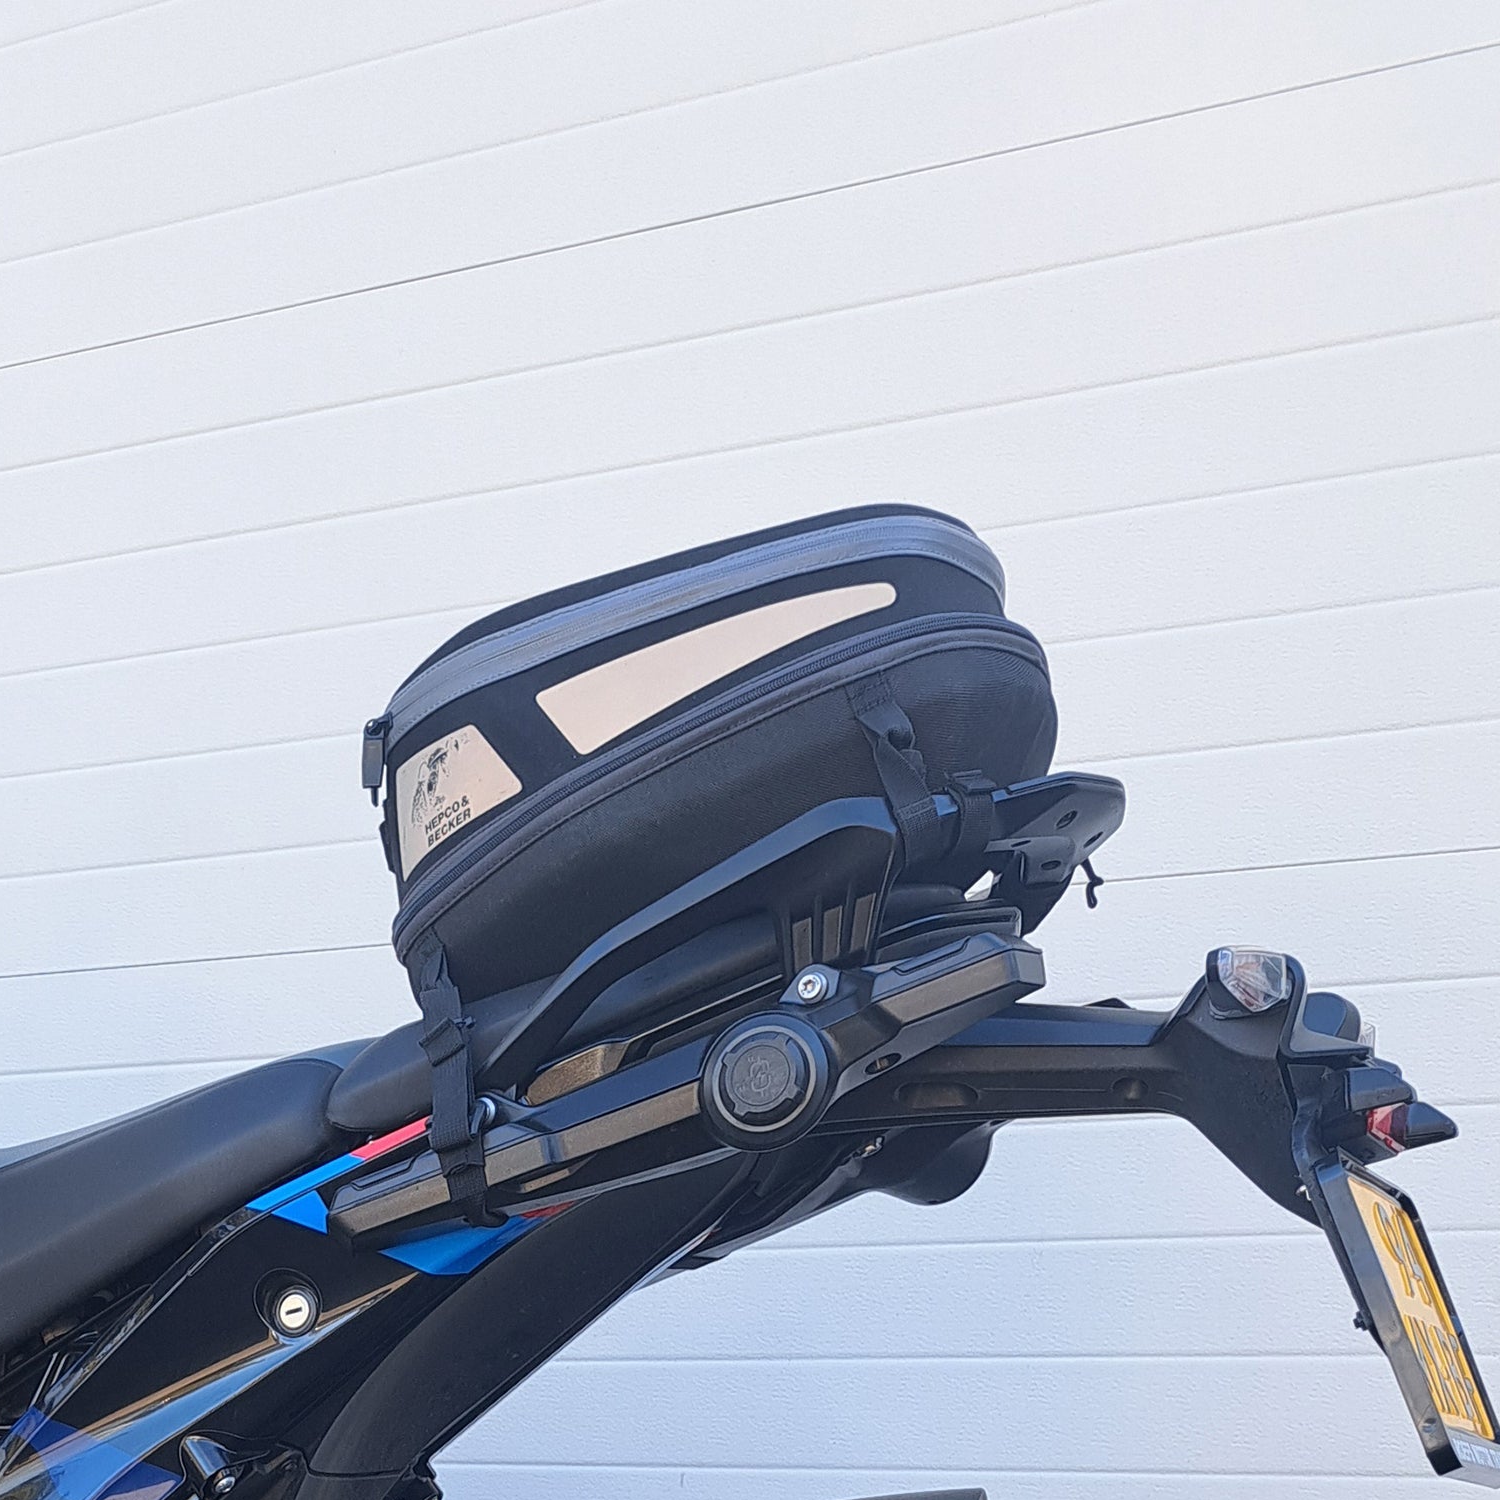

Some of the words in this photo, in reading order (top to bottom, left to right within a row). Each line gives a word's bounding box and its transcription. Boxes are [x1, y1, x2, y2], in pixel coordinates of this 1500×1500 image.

[425, 802, 462, 834] HEPCO
[460, 795, 471, 807] &
[427, 808, 472, 848] BECKER
